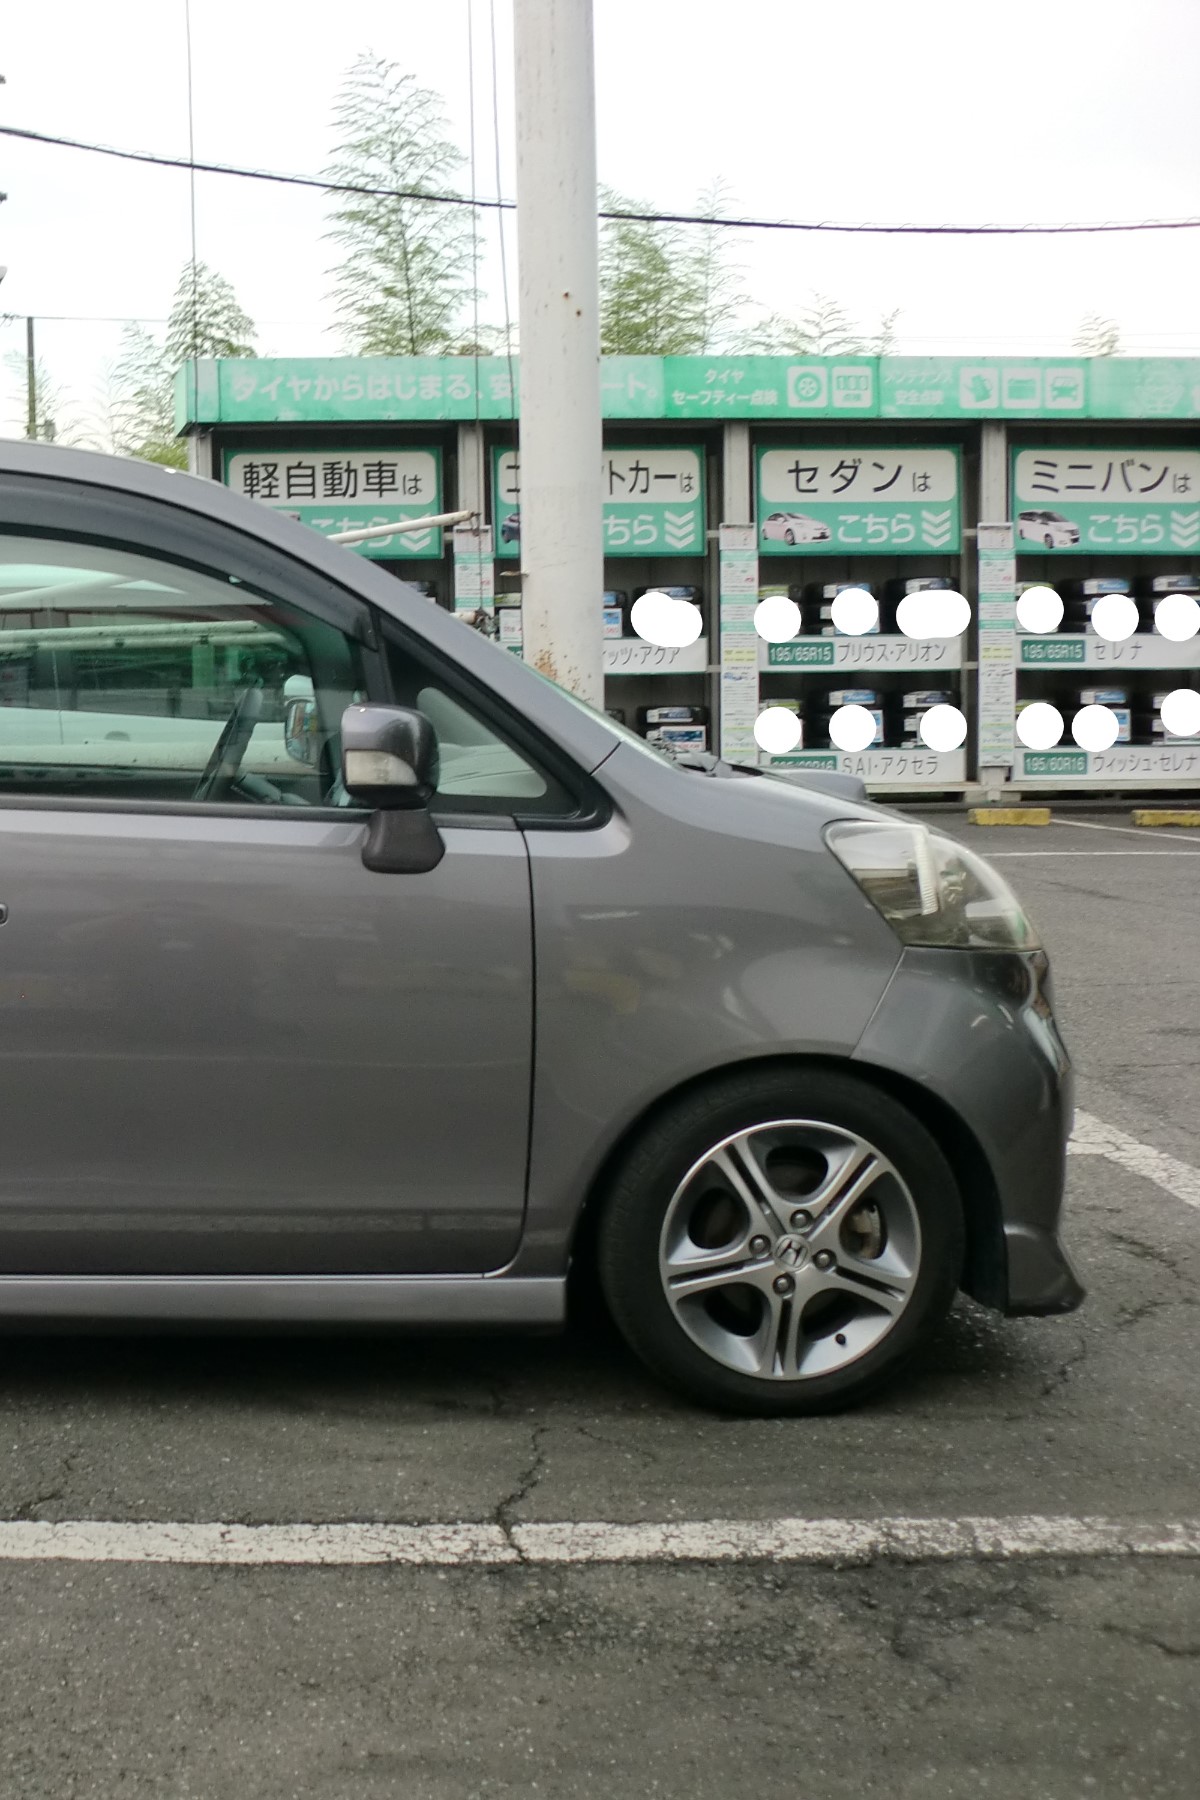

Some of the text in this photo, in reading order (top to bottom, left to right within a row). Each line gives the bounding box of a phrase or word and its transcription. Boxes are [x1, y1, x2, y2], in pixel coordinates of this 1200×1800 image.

[705, 369, 744, 384] タイヤ
[242, 460, 422, 499] 軽自動車は
[787, 458, 931, 494] セダンは
[1031, 458, 1191, 494] ミニバンは
[603, 514, 658, 545] ちら
[838, 514, 915, 544] こちら
[1088, 514, 1164, 544] こちら
[1094, 640, 1143, 660] セレナ
